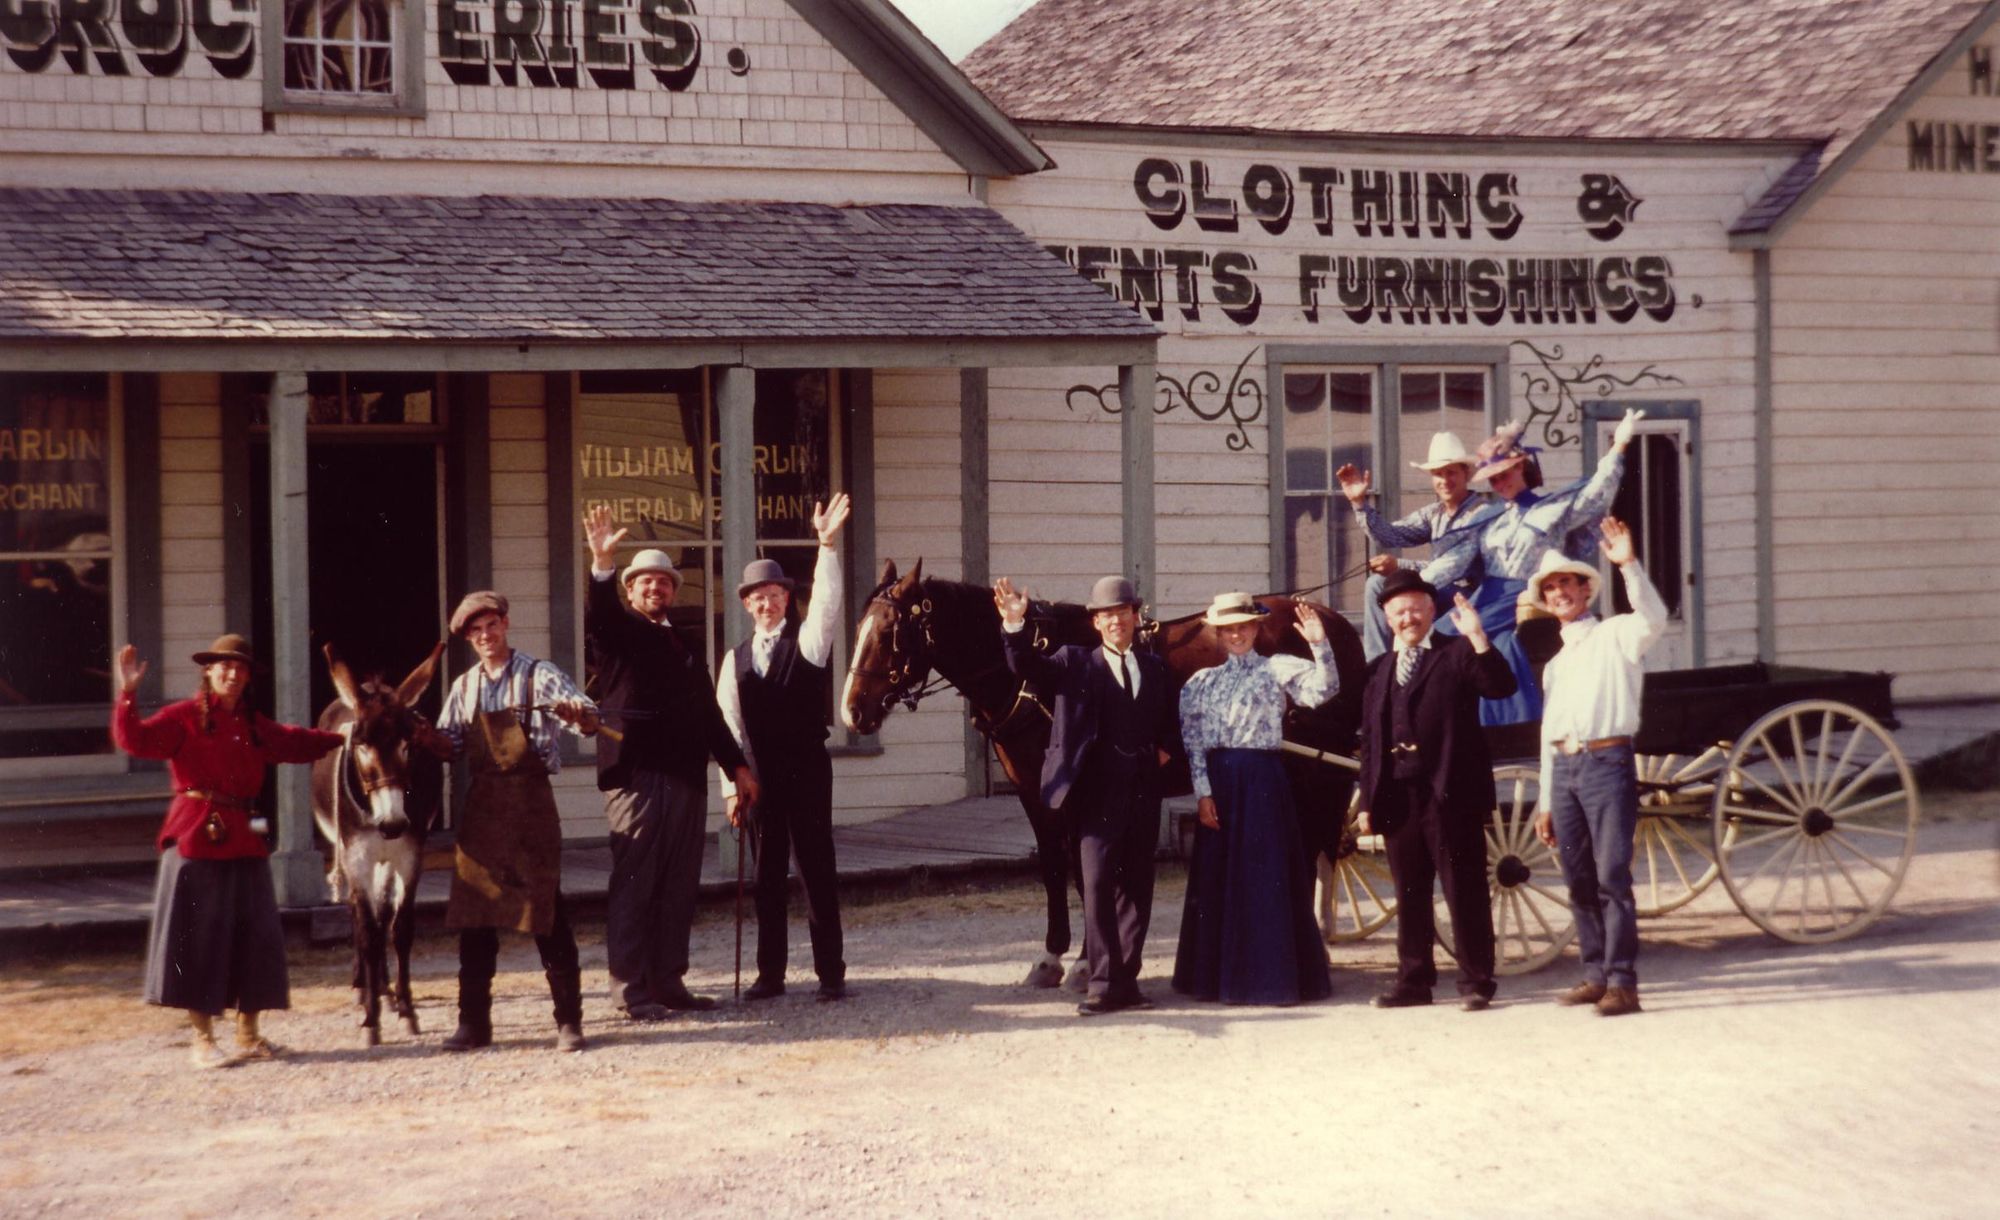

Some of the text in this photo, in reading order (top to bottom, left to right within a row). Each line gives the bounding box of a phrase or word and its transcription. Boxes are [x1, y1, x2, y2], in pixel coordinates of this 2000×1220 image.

[1133, 157, 1645, 242] CLOTHING &
[1045, 245, 1262, 327] ENTS
[710, 442, 817, 475] CRLIN
[582, 497, 683, 522] ENERAL
